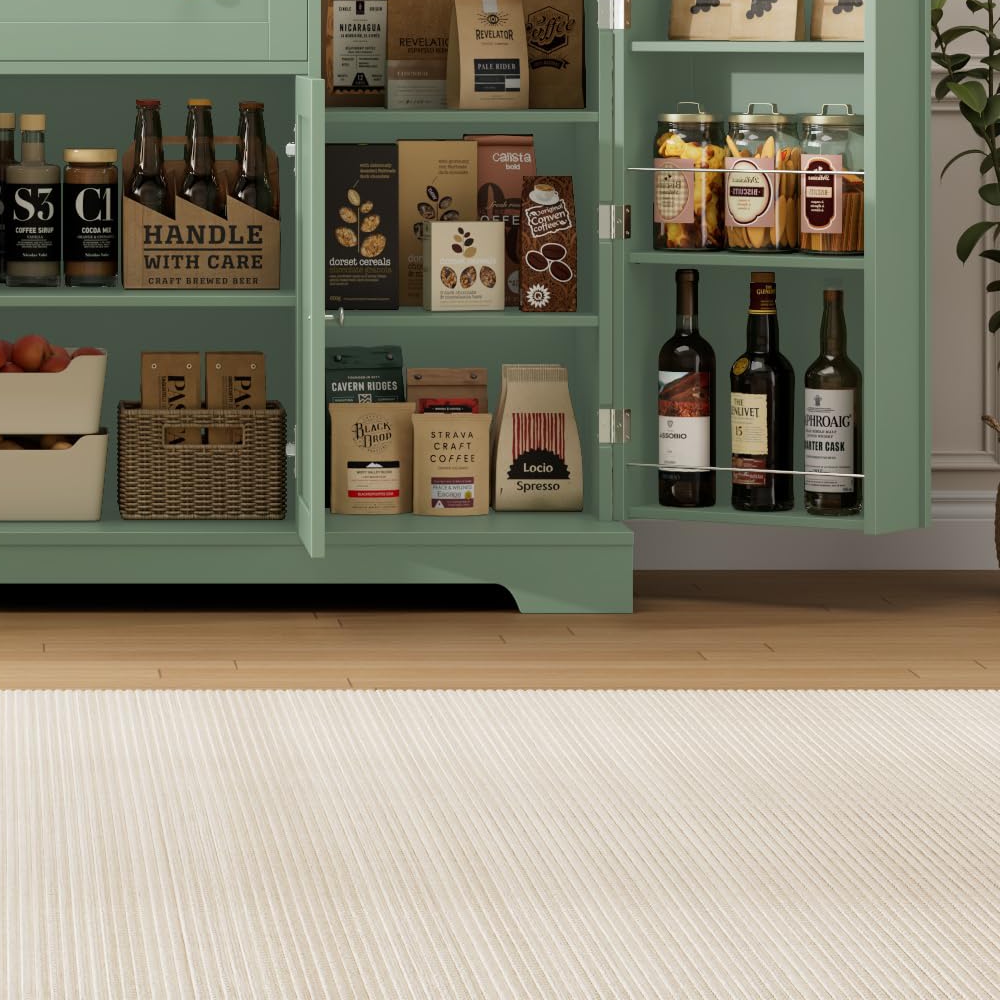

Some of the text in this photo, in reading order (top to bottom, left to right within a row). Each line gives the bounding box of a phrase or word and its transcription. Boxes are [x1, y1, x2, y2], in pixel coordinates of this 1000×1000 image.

[340, 24, 381, 32] NICARAGUA
[475, 29, 514, 40] REVELATOR
[13, 187, 54, 222] S3
[75, 187, 114, 222] C1
[531, 210, 565, 225] Conven
[144, 225, 263, 244] HANDLE
[144, 255, 263, 269] WITH CARE
[329, 257, 391, 266] dorset cereals
[332, 381, 398, 392] CAVERN RIDGES
[352, 422, 392, 440] BLACK
[735, 425, 743, 436] 15
[362, 432, 392, 448] DROP
[825, 441, 845, 452] CASK
[430, 454, 475, 462] COFFEE
[523, 462, 553, 473] Locio
[517, 481, 560, 494] Spresso
